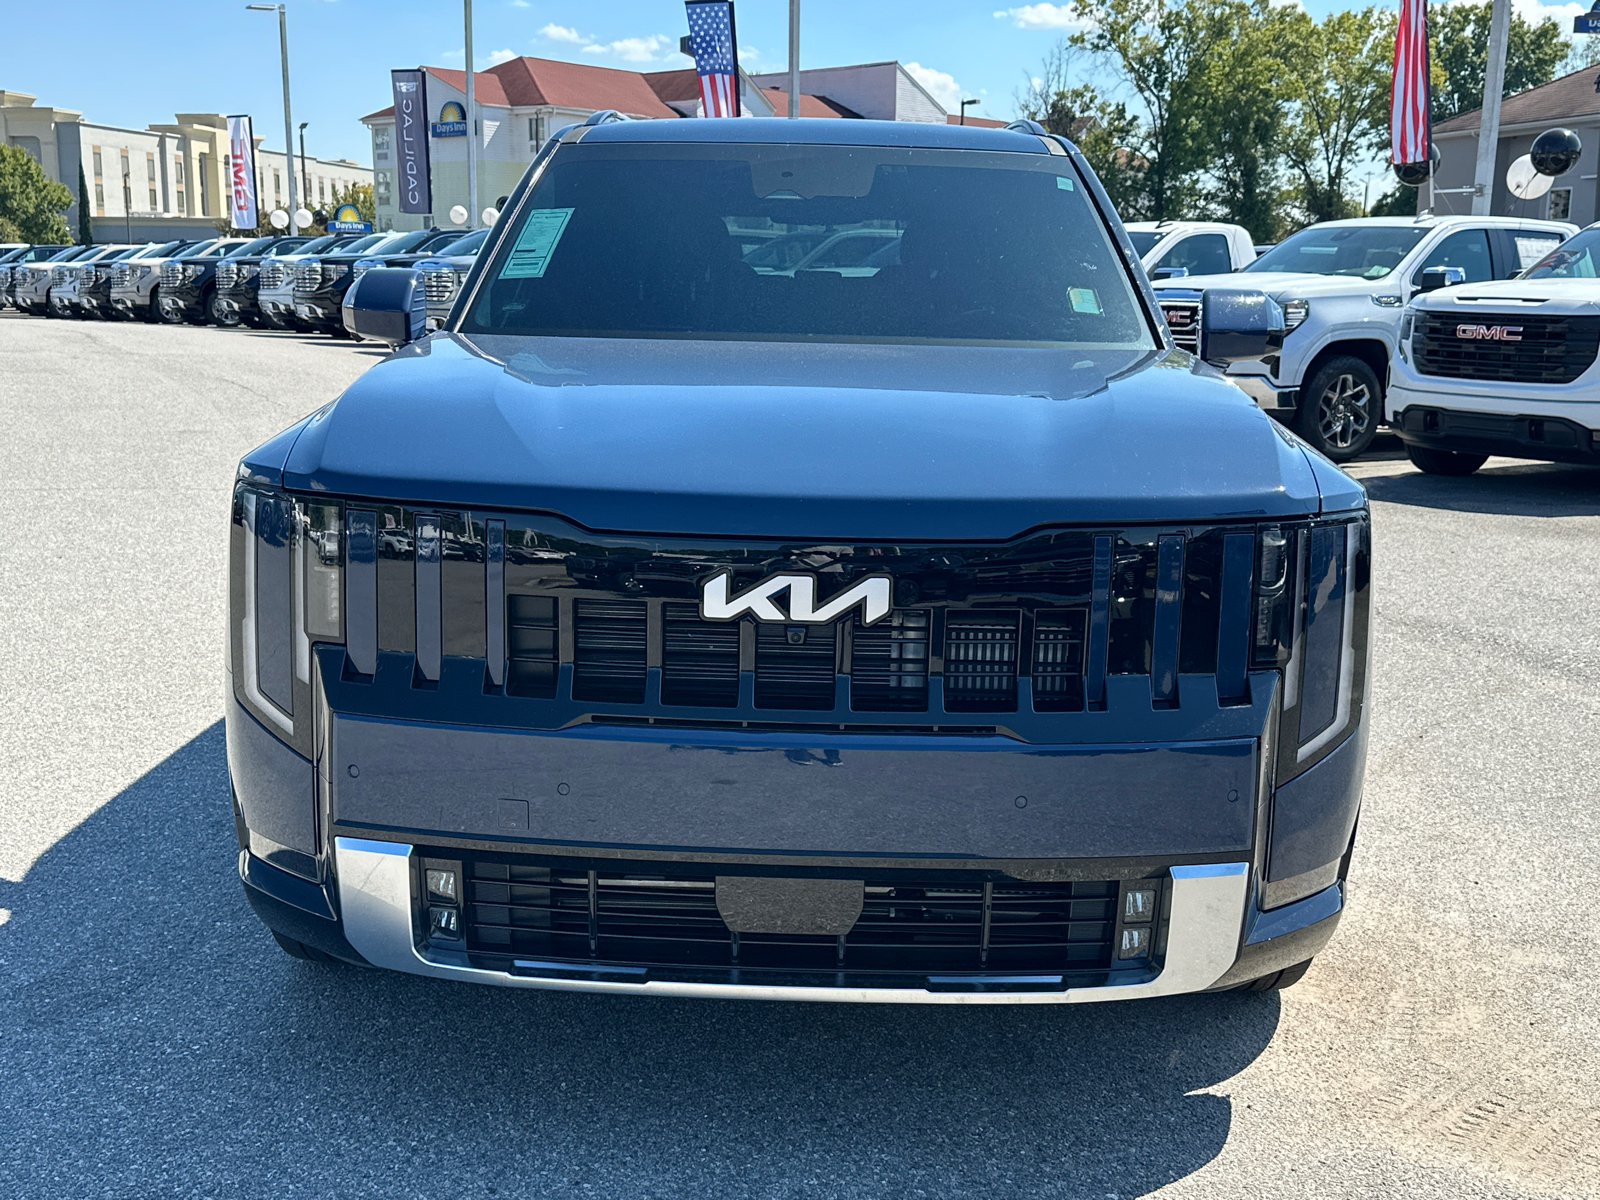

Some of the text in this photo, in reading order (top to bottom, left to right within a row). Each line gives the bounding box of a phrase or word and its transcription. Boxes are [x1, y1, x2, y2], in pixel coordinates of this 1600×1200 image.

[436, 122, 466, 133] Days Inn
[335, 221, 365, 231] Days Inn
[1163, 310, 1191, 323] MC
[1456, 324, 1524, 341] GMC
[702, 571, 891, 625] KIA
